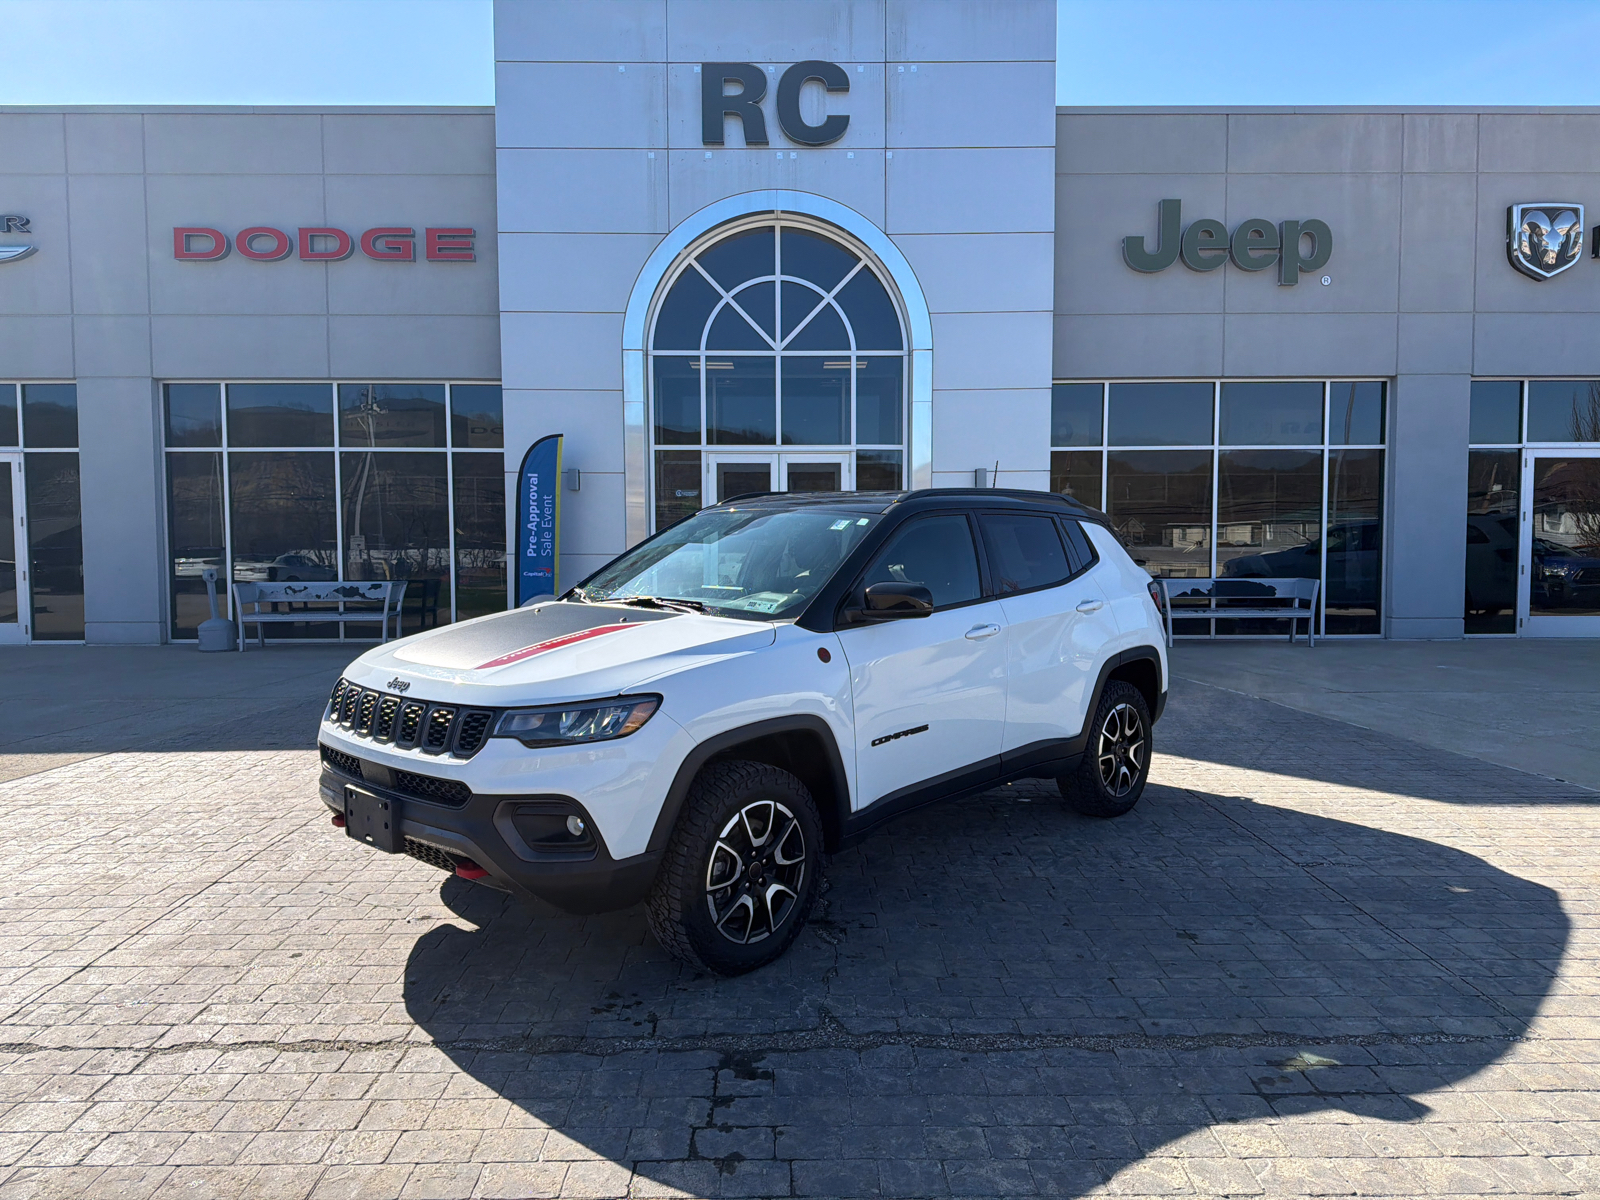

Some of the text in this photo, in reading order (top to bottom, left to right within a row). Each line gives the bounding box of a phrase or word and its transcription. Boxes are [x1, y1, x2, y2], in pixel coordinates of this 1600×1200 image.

[702, 60, 850, 147] RC
[173, 227, 476, 261] DODGE
[1122, 199, 1333, 286] Jeep
[527, 473, 540, 557] Pre-Approval
[541, 494, 553, 557] Sale Event
